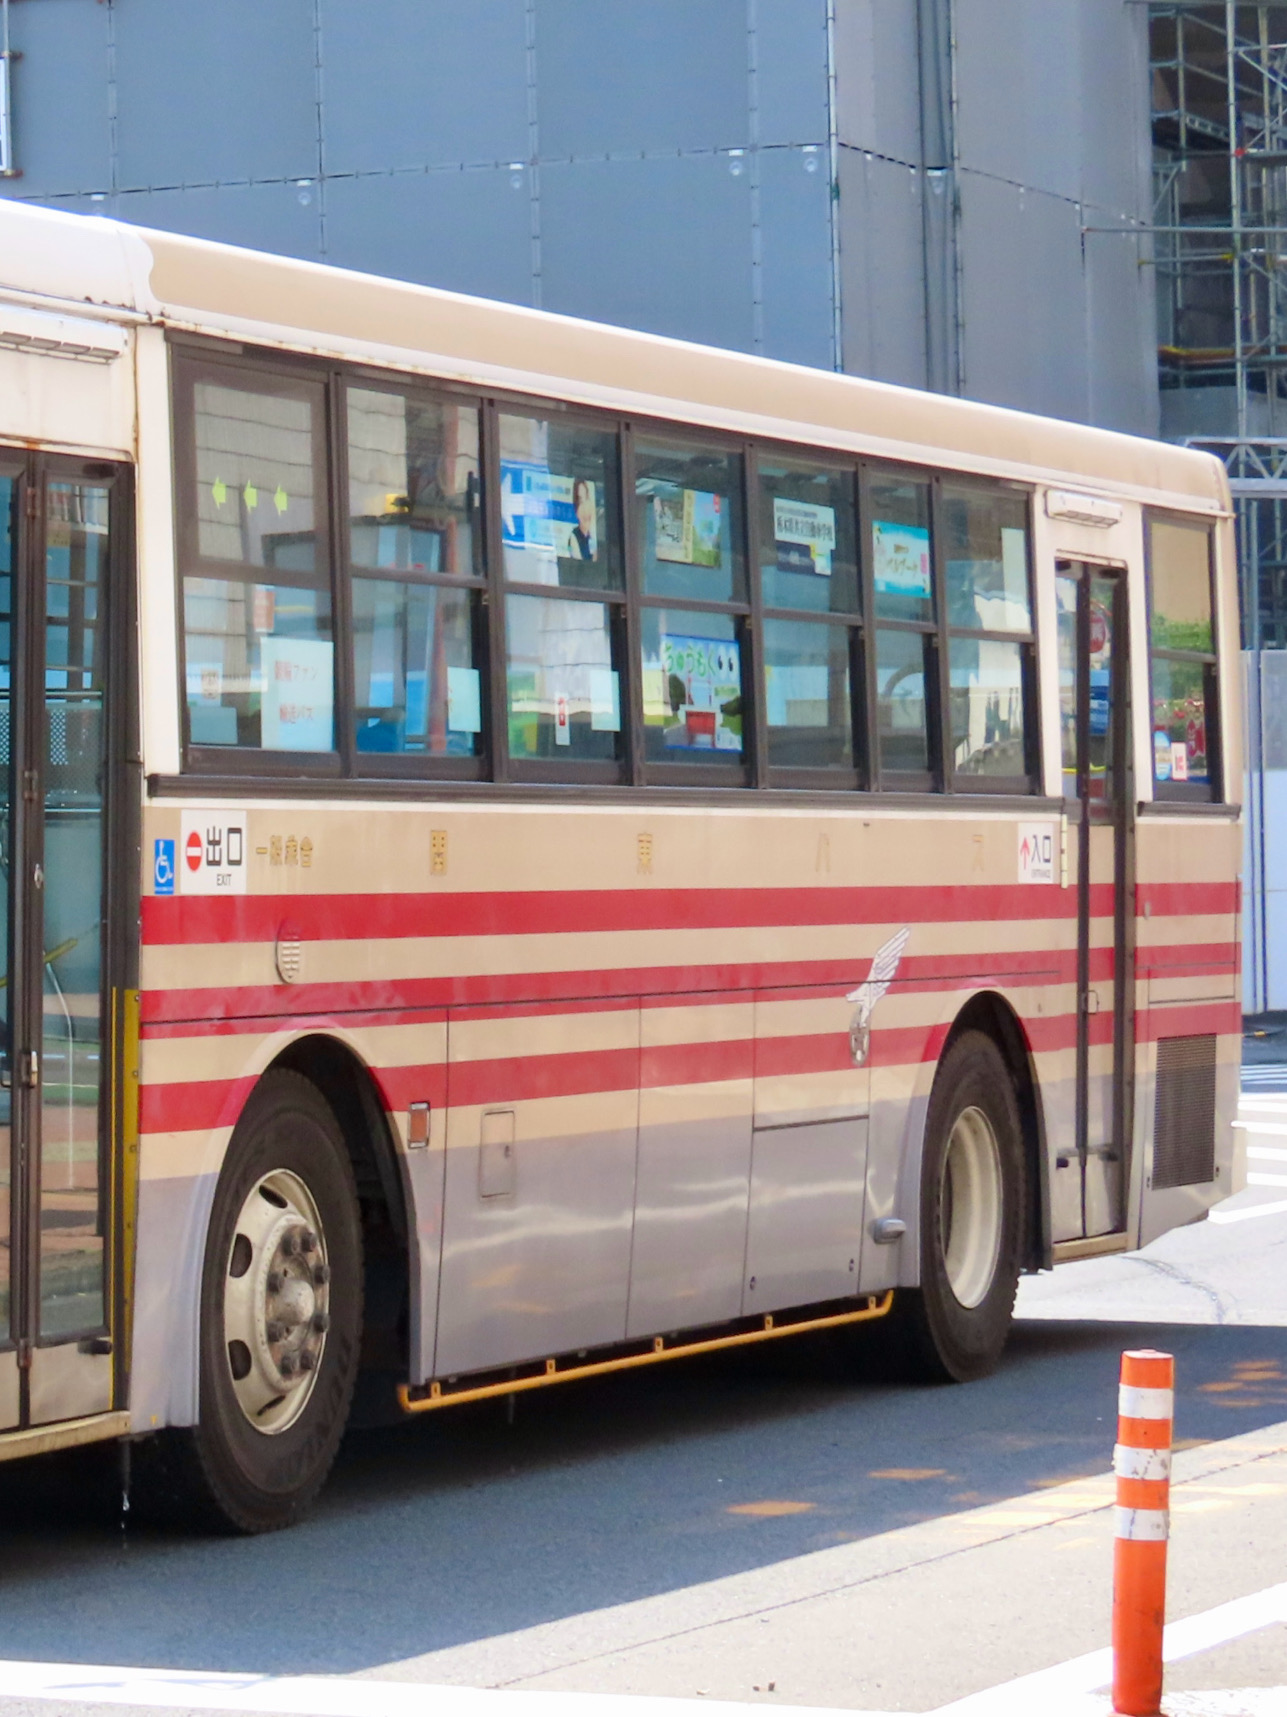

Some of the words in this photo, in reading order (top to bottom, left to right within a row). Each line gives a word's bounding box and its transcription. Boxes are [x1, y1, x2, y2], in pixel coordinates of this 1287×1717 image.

[206, 826, 243, 867] 出口
[1031, 834, 1052, 864] 入口
[216, 873, 233, 887] EXIT
